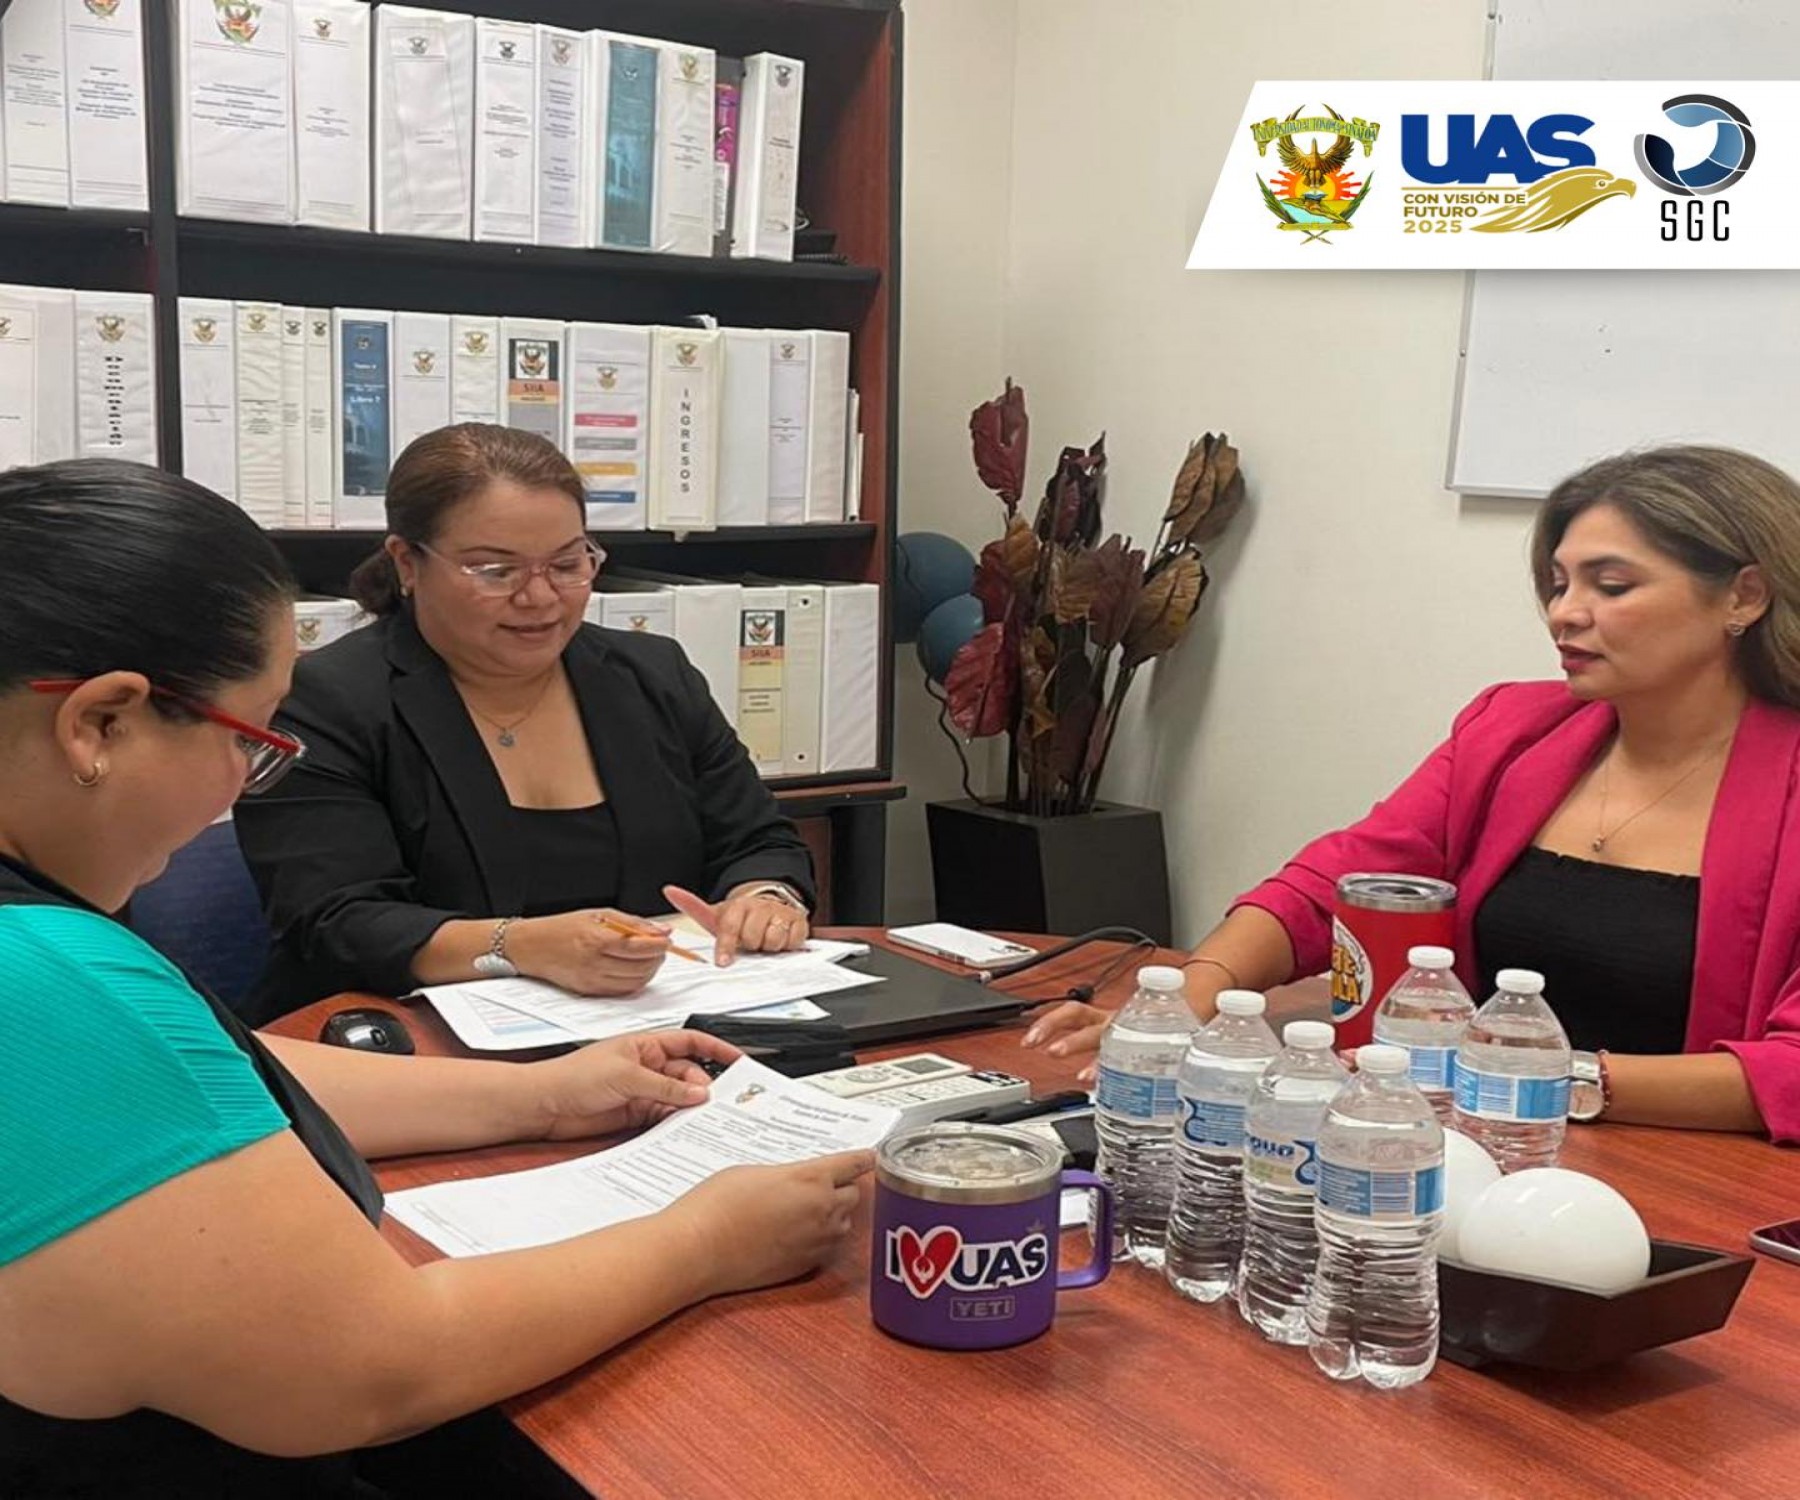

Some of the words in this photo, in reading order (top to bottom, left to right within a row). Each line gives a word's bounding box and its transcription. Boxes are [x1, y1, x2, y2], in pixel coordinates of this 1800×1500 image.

[680, 387, 692, 493] INGRESOS
[950, 1236, 1048, 1288] UAS
[957, 1300, 1011, 1317] YETI
